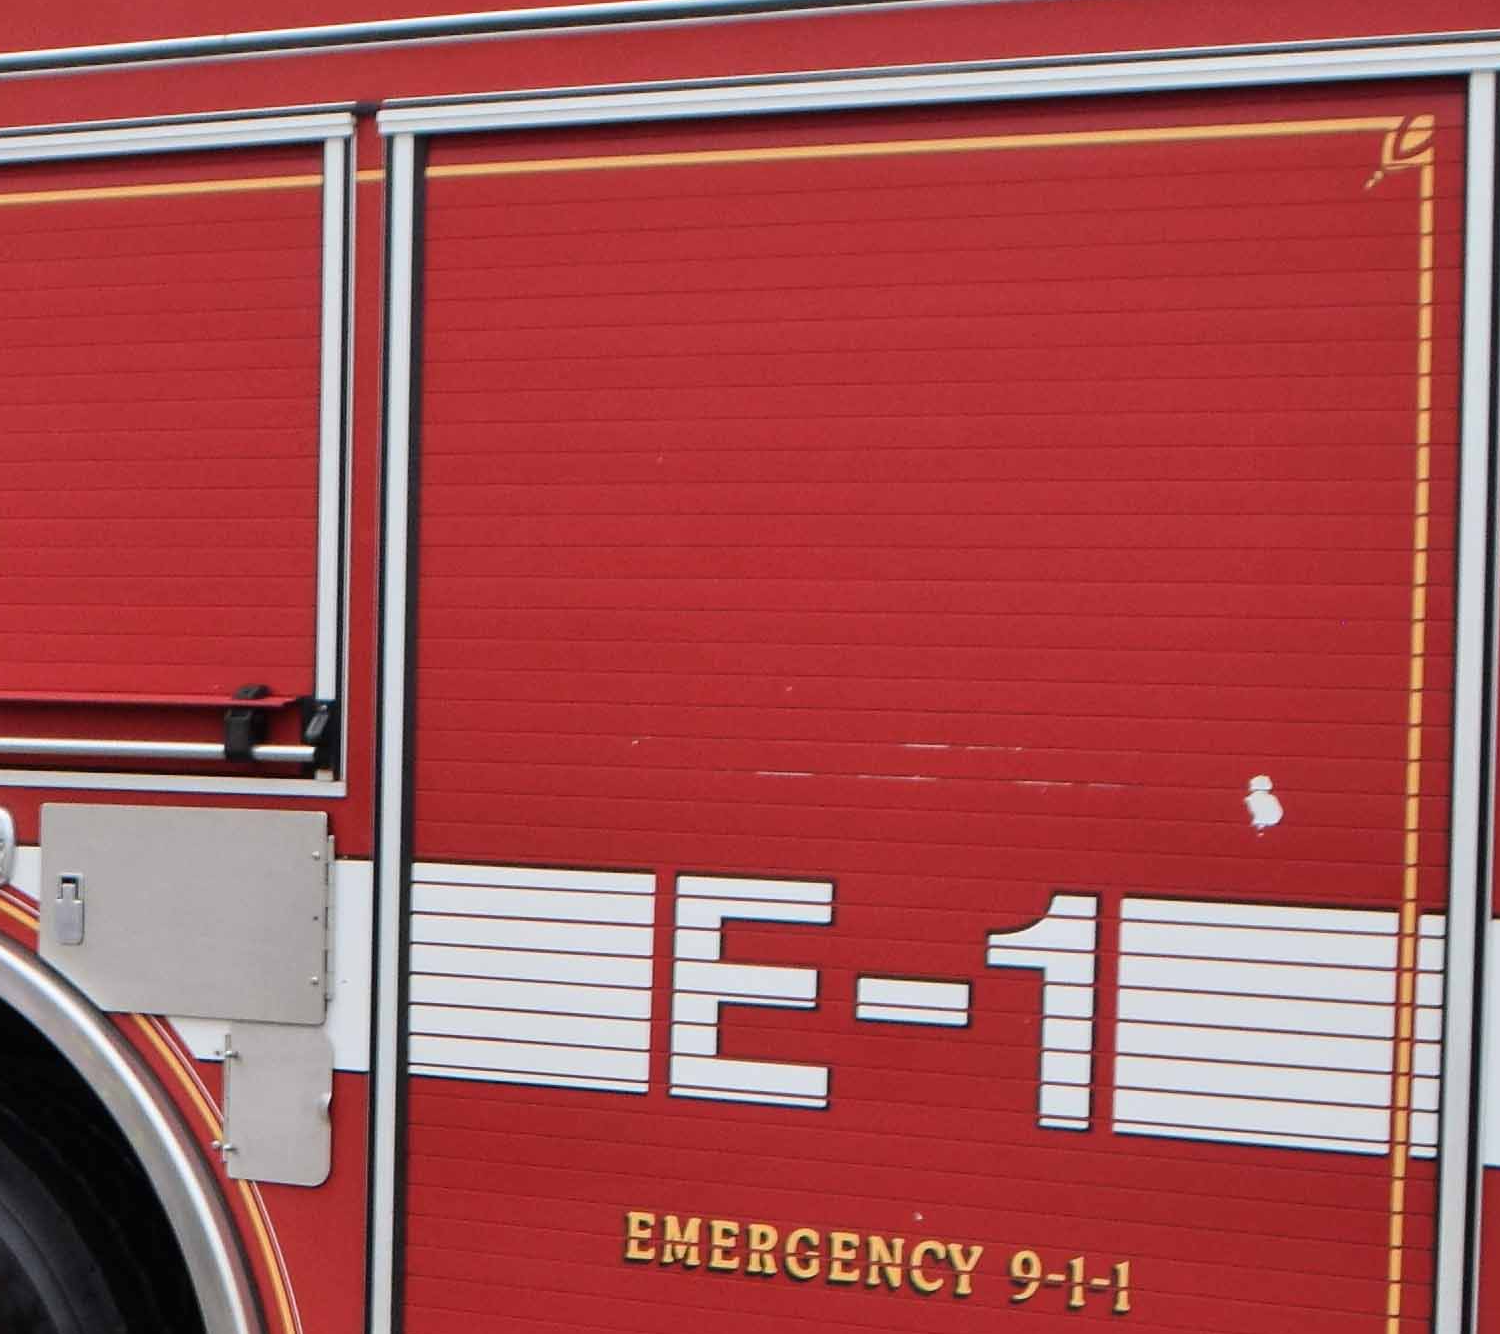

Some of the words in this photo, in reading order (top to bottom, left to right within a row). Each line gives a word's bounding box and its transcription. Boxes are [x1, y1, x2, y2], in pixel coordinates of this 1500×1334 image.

[669, 873, 1102, 1132] E-1
[623, 1210, 983, 1298] EMERGENCY
[1009, 1249, 1133, 1315] 9-1-1
